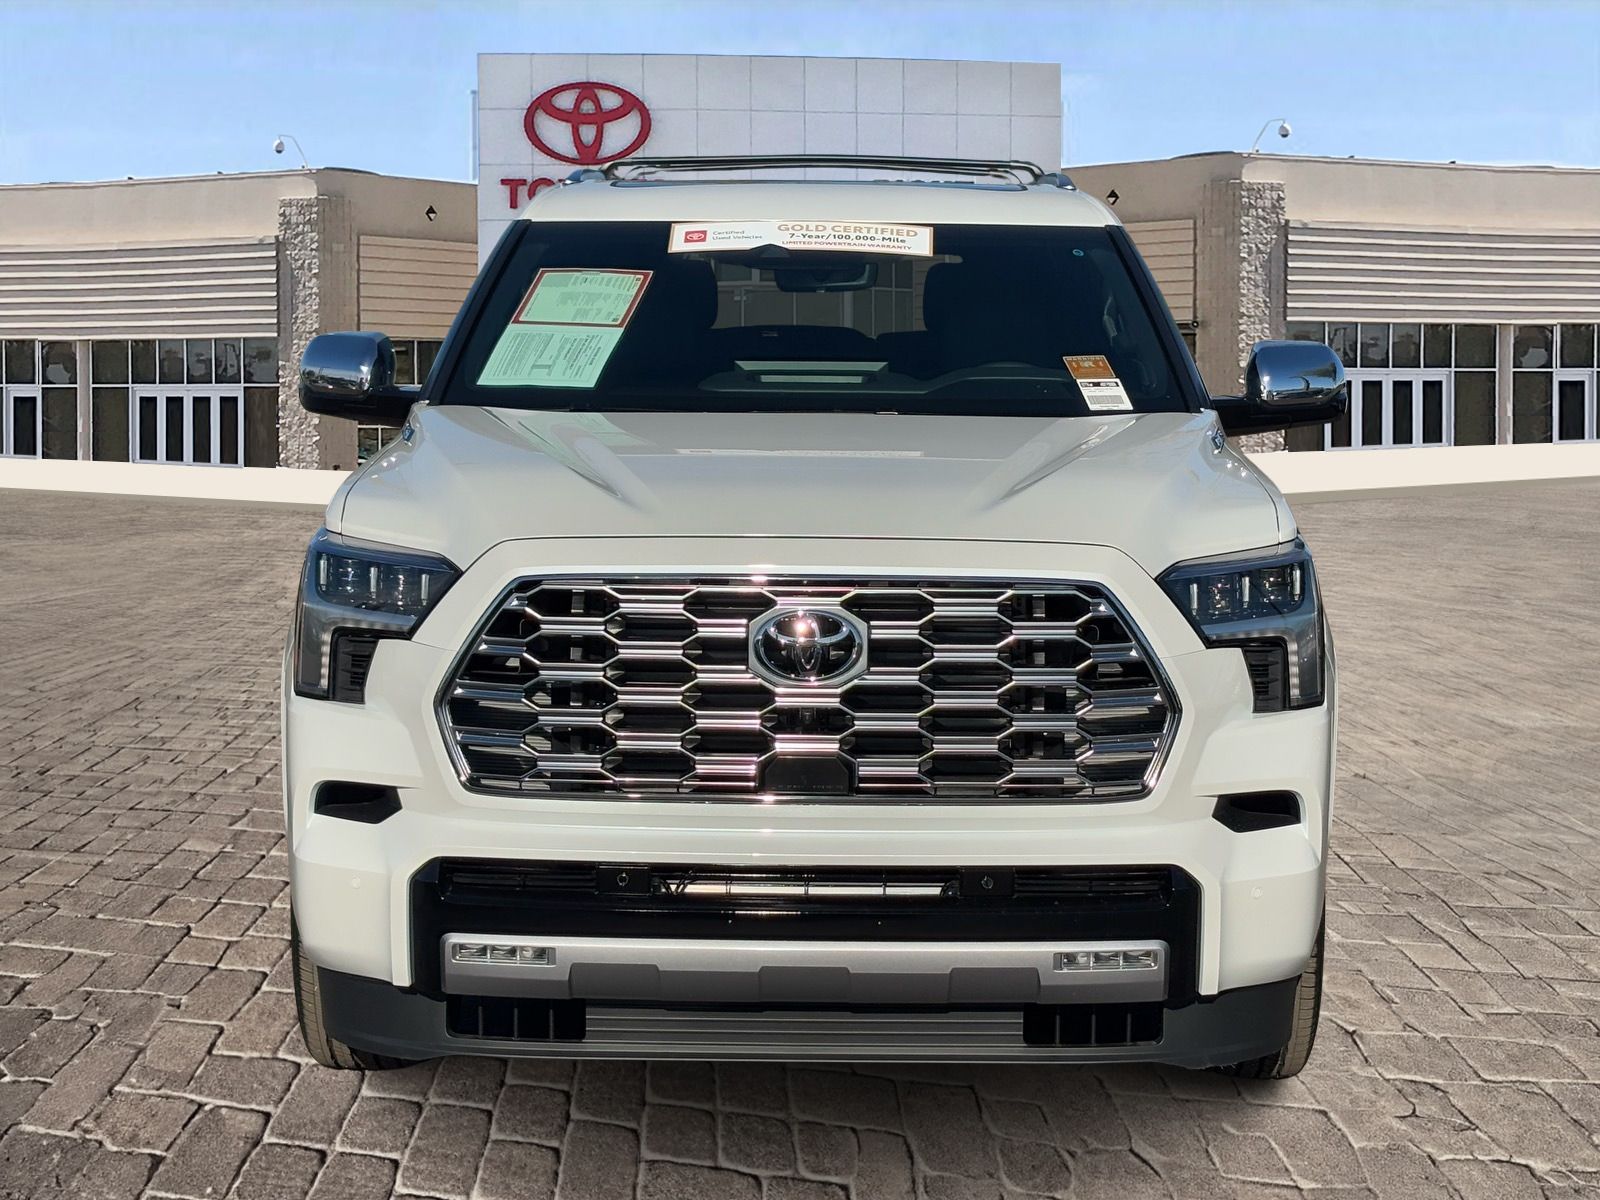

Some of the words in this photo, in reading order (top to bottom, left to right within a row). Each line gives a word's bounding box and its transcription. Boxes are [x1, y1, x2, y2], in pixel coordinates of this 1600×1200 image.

[777, 224, 827, 232] GOLD
[830, 225, 918, 237] CERTIFIED
[789, 233, 906, 244] 7-Year/100,000-Mile
